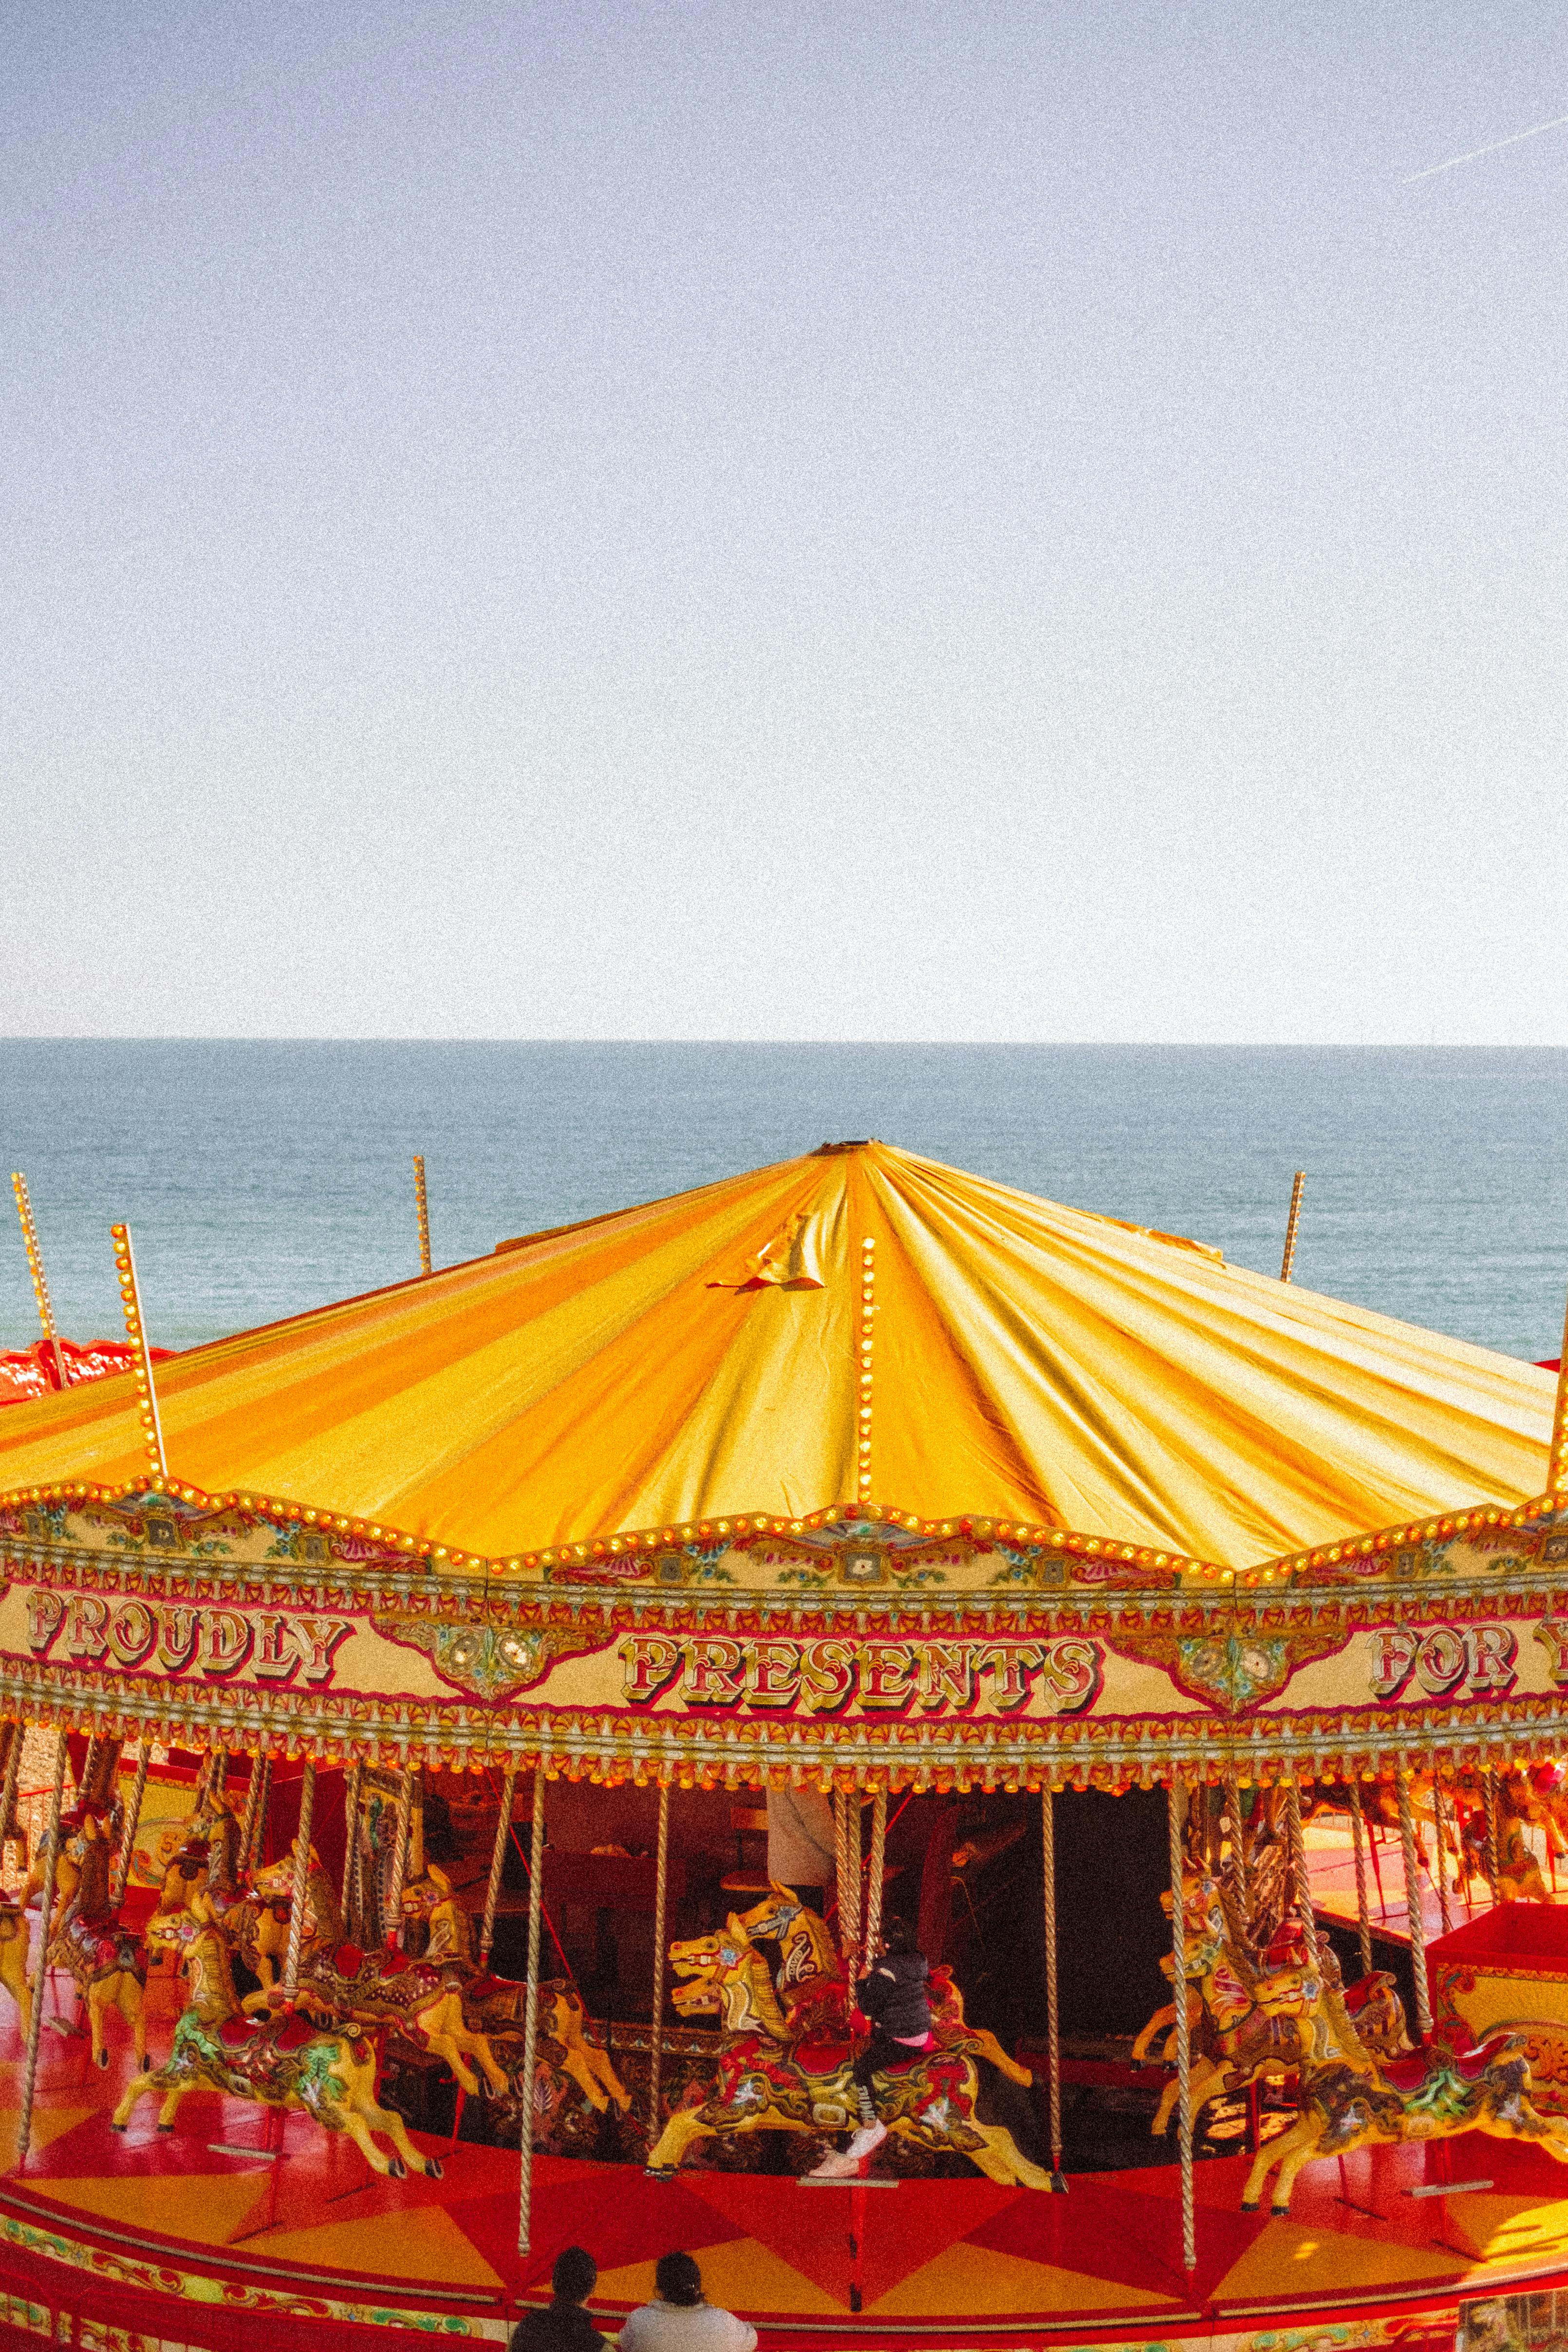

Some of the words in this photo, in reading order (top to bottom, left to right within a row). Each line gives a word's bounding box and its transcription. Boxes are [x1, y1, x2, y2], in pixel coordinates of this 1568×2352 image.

[26, 1587, 356, 1689] PROUDLY
[618, 1635, 1105, 1715] PRESENTS
[1365, 1624, 1518, 1703] FOR
[788, 1949, 803, 1976] DAVID
